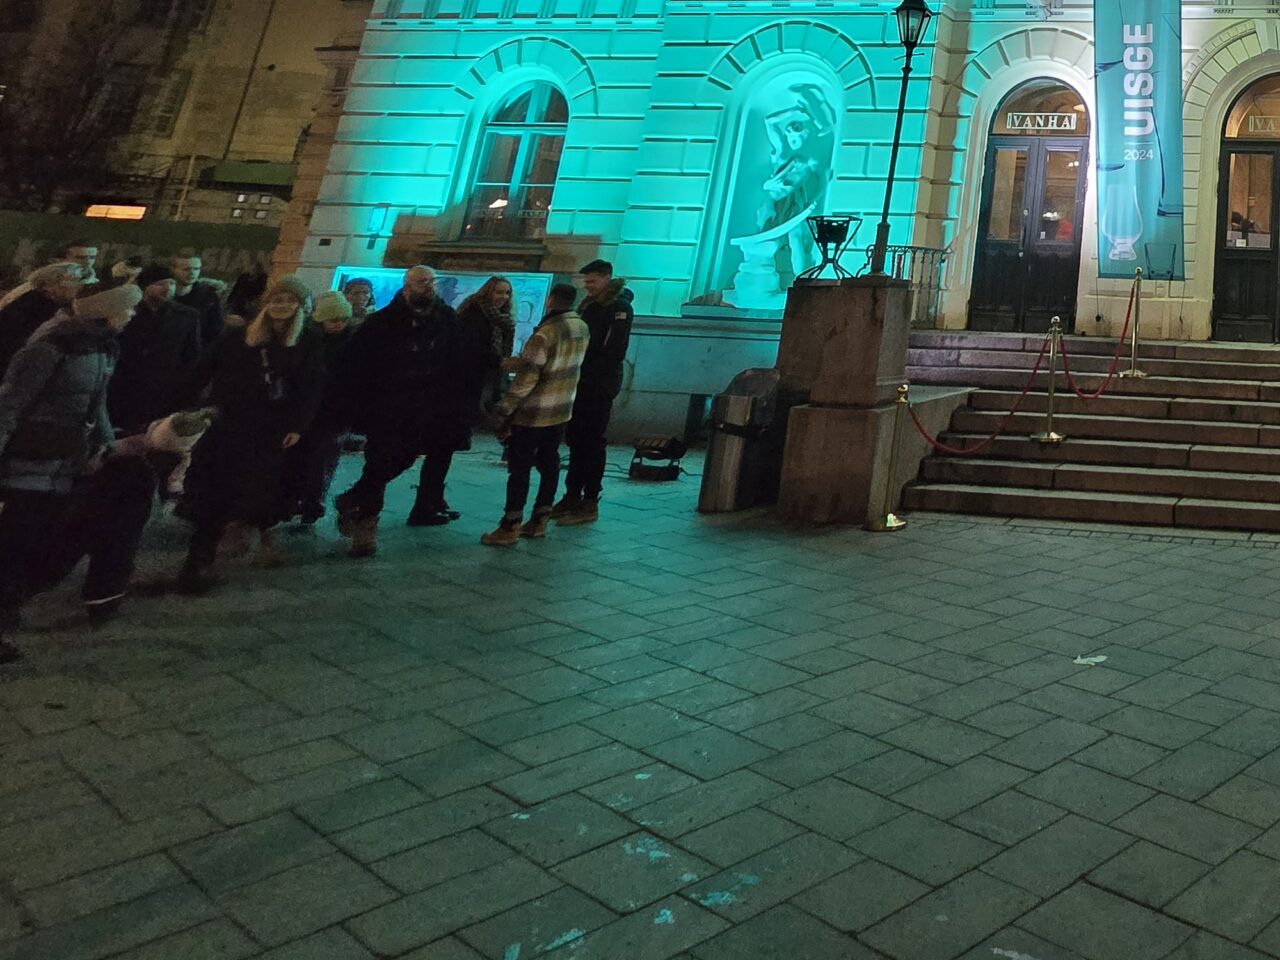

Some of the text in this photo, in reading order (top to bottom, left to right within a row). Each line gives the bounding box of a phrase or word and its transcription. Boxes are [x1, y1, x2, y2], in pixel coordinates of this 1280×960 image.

[1123, 23, 1154, 136] UISGE
[1013, 115, 1072, 129] VANHA
[1124, 149, 1153, 161] 2024
